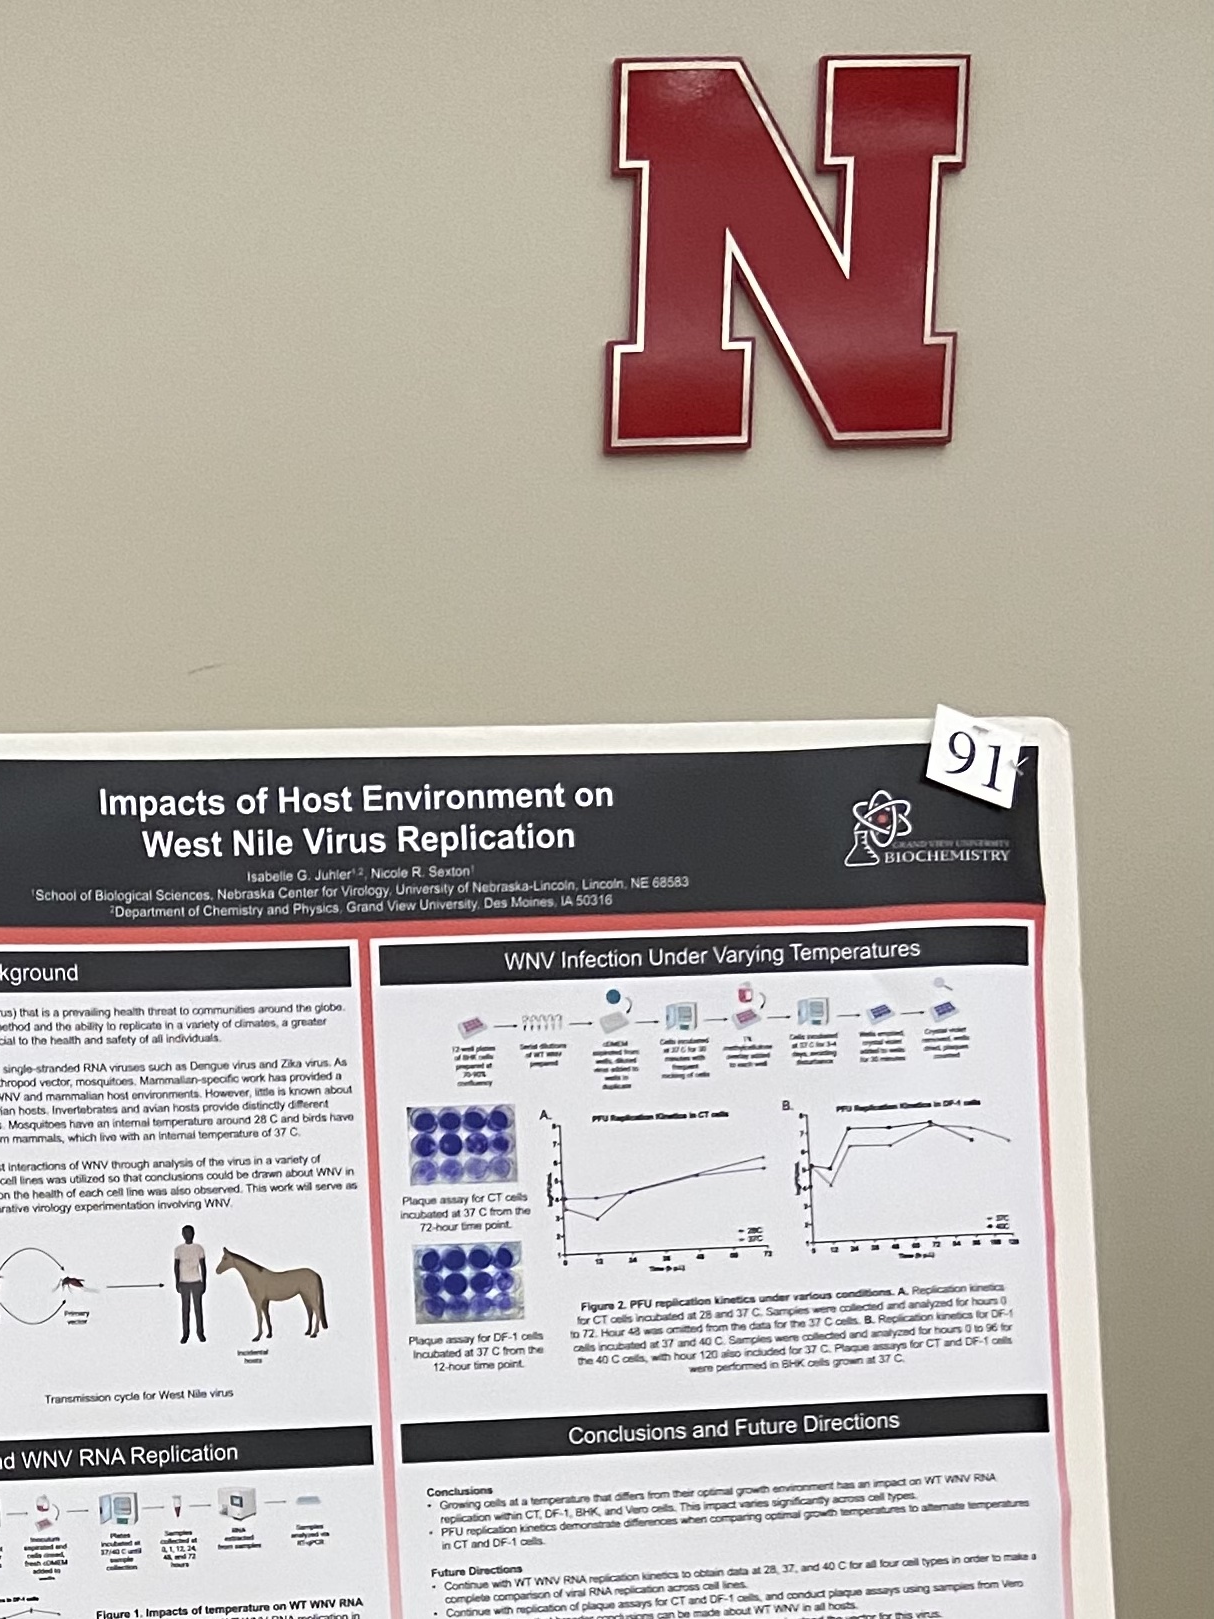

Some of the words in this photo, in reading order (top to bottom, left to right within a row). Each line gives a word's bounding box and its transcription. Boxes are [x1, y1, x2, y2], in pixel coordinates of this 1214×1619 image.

[604, 54, 971, 453] N
[945, 730, 1003, 793] 91
[99, 789, 225, 821] Impacts
[236, 786, 268, 814] of
[278, 786, 352, 813] Host
[362, 784, 566, 811] Environment
[574, 787, 613, 806] on
[141, 830, 222, 857] West
[232, 829, 293, 856] Nile
[302, 827, 386, 854] Virus
[397, 823, 574, 856] Replication
[884, 849, 1009, 863] BIOCHEMISTRY
[246, 871, 293, 882] Isabelle
[296, 869, 310, 881] G.
[370, 867, 408, 878] Nicole
[79, 889, 92, 901] of
[94, 889, 152, 903] Biological
[217, 888, 274, 900] Nebraska
[278, 886, 319, 898] Center
[321, 885, 338, 897] for
[340, 885, 392, 898] Virology,
[395, 883, 454, 896] University
[456, 881, 469, 893] of
[472, 880, 578, 892] Nebraska-Lincoln,
[630, 876, 650, 888] NE
[652, 876, 689, 888] 68583
[187, 904, 200, 917] of
[202, 904, 263, 917] Chemistry
[266, 904, 289, 915] and
[346, 900, 384, 912] Grand
[386, 900, 416, 911] View
[484, 896, 508, 908] Des
[560, 895, 573, 906] IA
[576, 894, 612, 906] 50316
[504, 951, 555, 970] WNV
[561, 950, 642, 968] Infection
[648, 948, 708, 965] Under
[712, 945, 784, 966] Varying
[788, 943, 921, 962] Temperatures
[400, 1209, 448, 1219] incubated
[451, 1209, 461, 1218] at
[463, 1207, 476, 1217] 37
[478, 1207, 487, 1217] C
[489, 1207, 513, 1216] from
[514, 1206, 531, 1215] the
[44, 1394, 111, 1404] Transmission
[113, 1392, 140, 1403] cycle
[142, 1391, 156, 1400] for
[158, 1390, 184, 1399] West
[187, 1389, 207, 1398] Nile
[209, 1389, 234, 1397] virus
[568, 1424, 686, 1444] Conclusions
[692, 1420, 728, 1438] and
[734, 1418, 798, 1435] Future
[803, 1413, 900, 1432] Directions
[20, 1449, 72, 1468] WNV
[79, 1447, 126, 1466] RNA
[130, 1444, 238, 1466] Replication
[426, 1487, 493, 1497] Conclusions
[430, 1568, 466, 1577] Future
[468, 1566, 523, 1575] Directions
[145, 1607, 188, 1618] Impacts
[190, 1605, 202, 1615] of
[204, 1604, 270, 1615] temperature
[272, 1603, 286, 1611] on
[288, 1600, 307, 1610] WT
[309, 1599, 336, 1609] WNV
[338, 1597, 364, 1607] RNA
